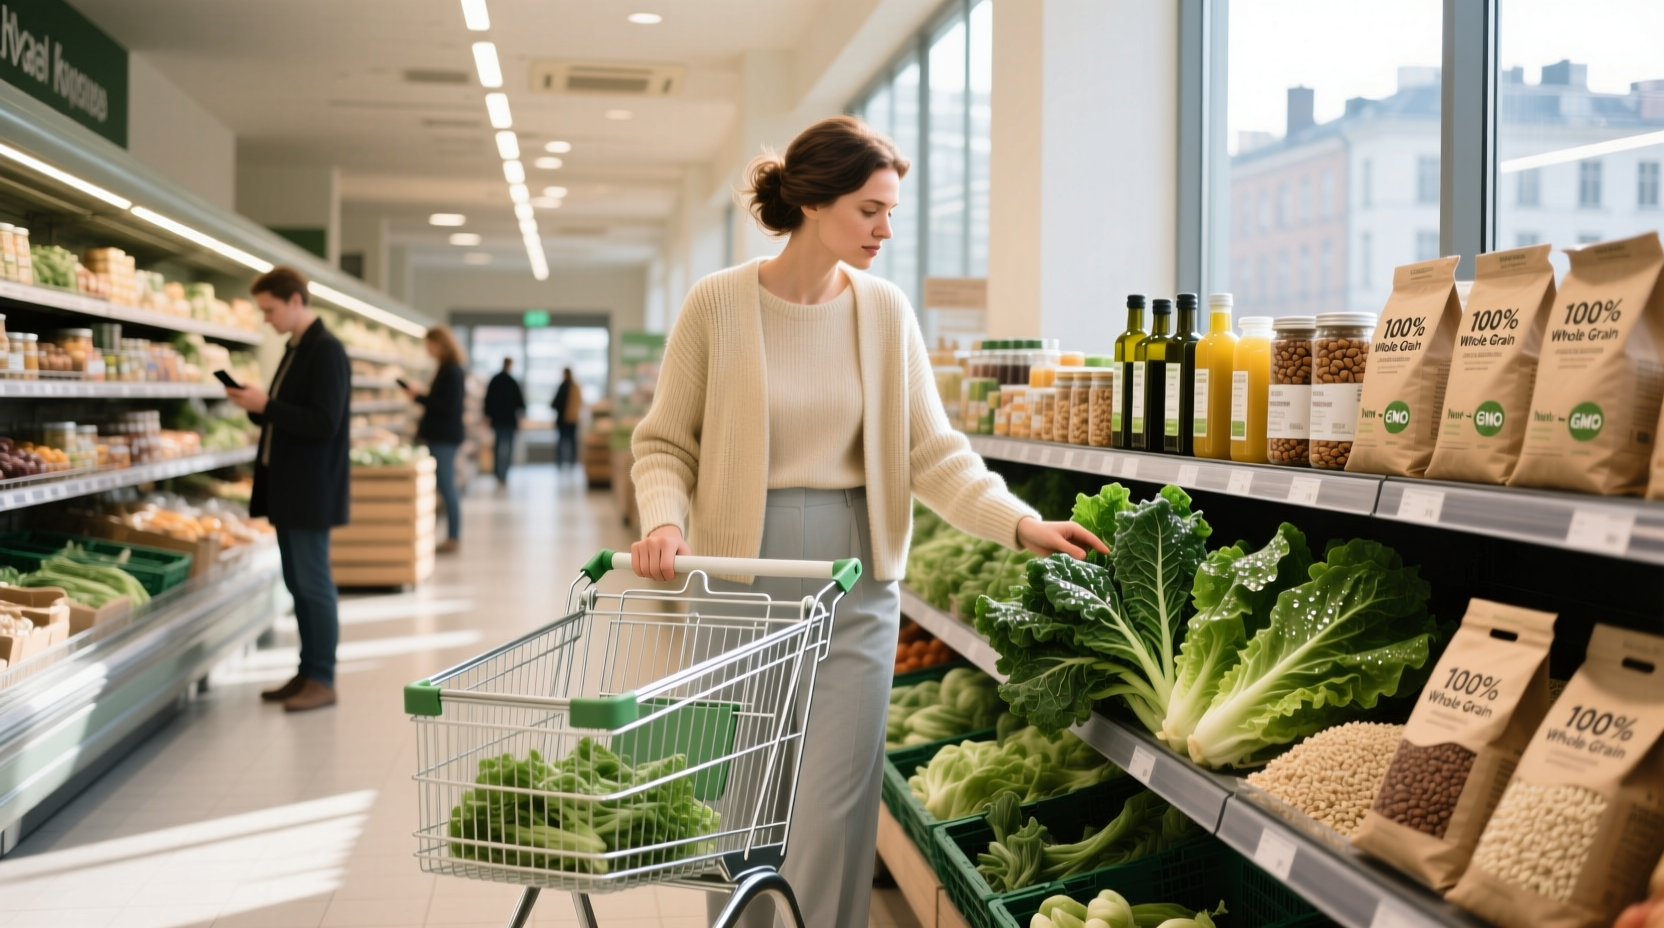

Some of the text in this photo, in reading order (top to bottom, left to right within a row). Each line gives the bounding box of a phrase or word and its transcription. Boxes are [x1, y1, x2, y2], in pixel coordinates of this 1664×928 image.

[1471, 308, 1520, 332] 100%
[1565, 298, 1623, 325] 100%
[1383, 316, 1427, 340] 100%
[1460, 333, 1516, 347] Whole Grain
[1551, 327, 1619, 342] Whole Grain
[1385, 410, 1409, 425] GMO
[1475, 411, 1504, 427] GMO
[1570, 412, 1603, 431] GMO
[1443, 667, 1502, 701] 100%
[1428, 689, 1494, 719] Whole Grain
[1565, 705, 1639, 741] 100%
[1546, 727, 1627, 759] Whole Grain
